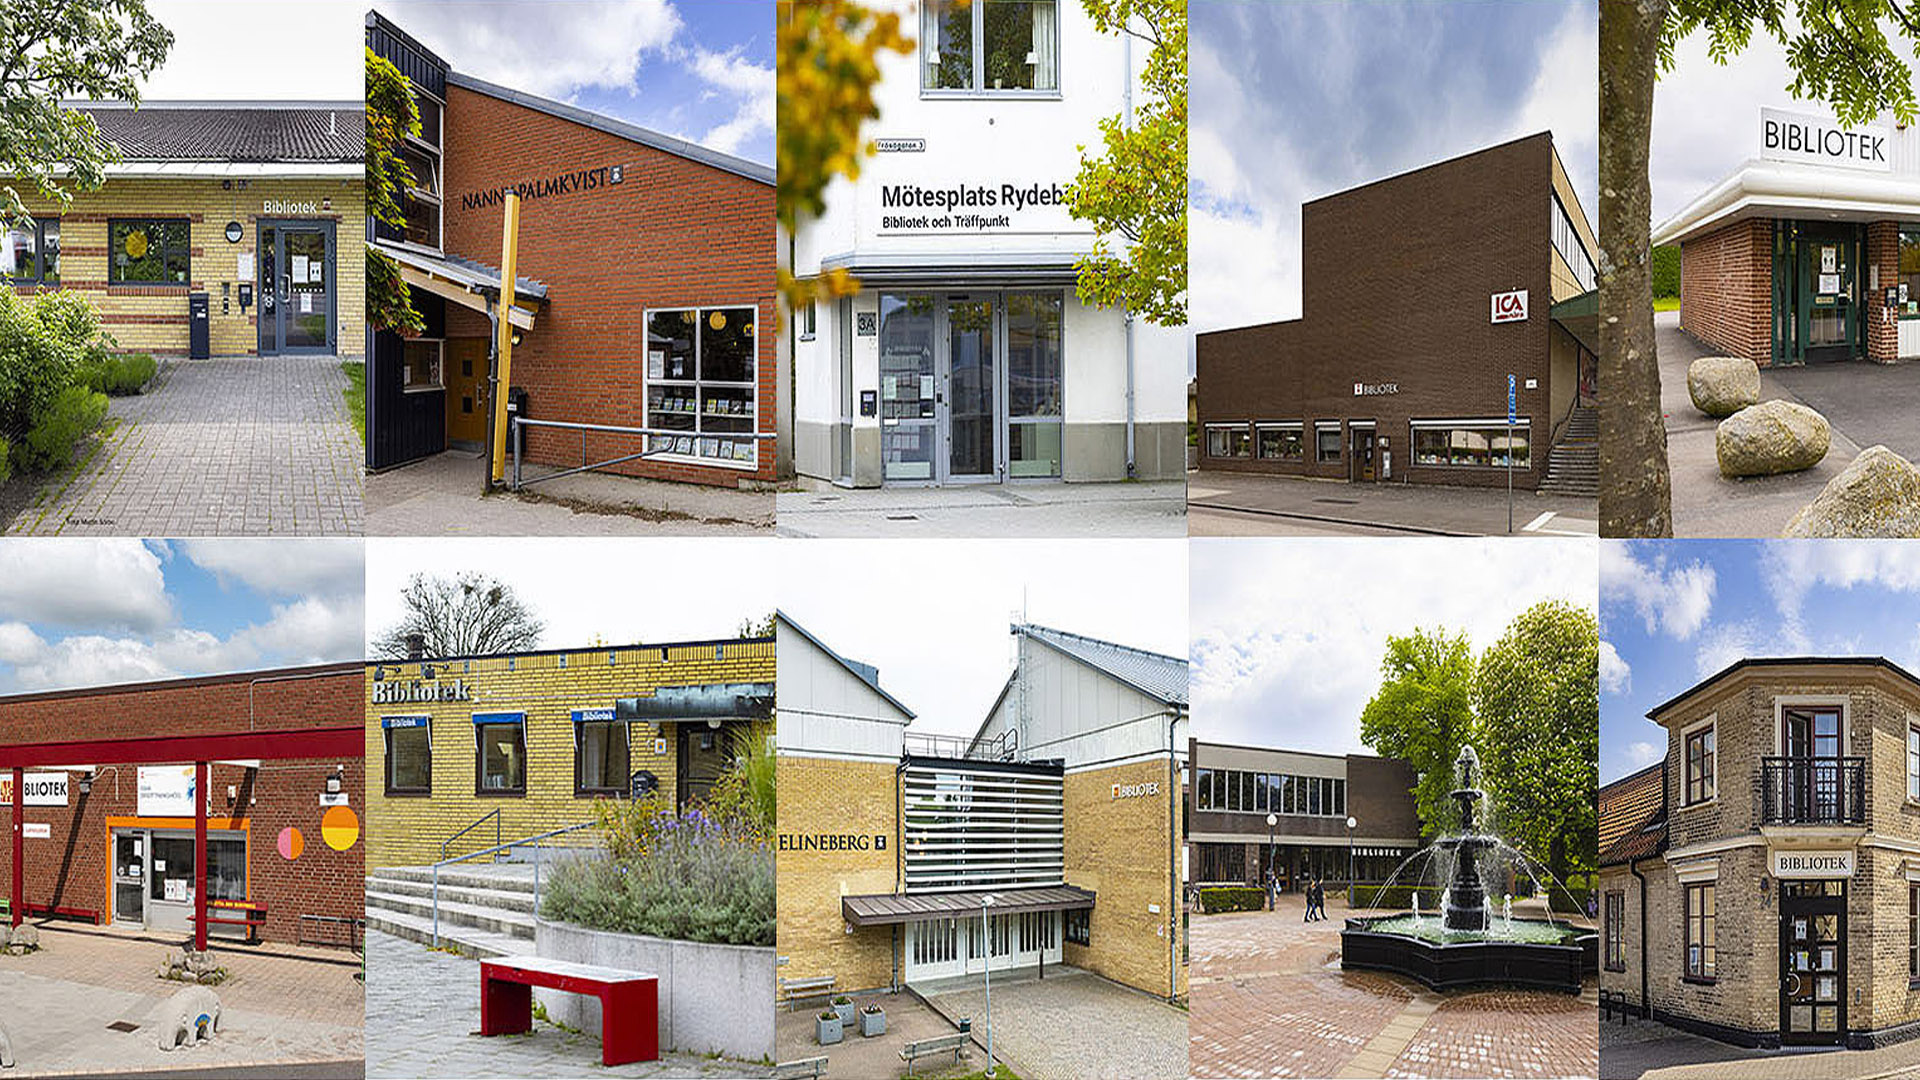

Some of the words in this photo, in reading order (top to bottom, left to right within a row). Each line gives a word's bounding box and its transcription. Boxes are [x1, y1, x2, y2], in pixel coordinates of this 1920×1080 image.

[1765, 120, 1885, 162] BIBLIOTEK
[519, 166, 609, 202] PALMKVIST
[882, 184, 997, 212] Mötesplats
[1001, 183, 1069, 211] Rydeb
[263, 199, 317, 214] Bibliotek
[882, 216, 929, 228] Bibliotek
[932, 216, 951, 228] och
[954, 215, 1010, 230] Träffpunkt
[1496, 294, 1524, 314] ICA
[859, 317, 876, 331] 3A
[1364, 383, 1400, 396] BIBLIOTEK
[371, 679, 471, 705] Bibliotek
[24, 781, 67, 797] BLIOTEK
[1121, 782, 1160, 798] BIBLIOTEK
[778, 834, 869, 851] ELINEBERG
[1780, 856, 1848, 870] BIBLIOTEK
